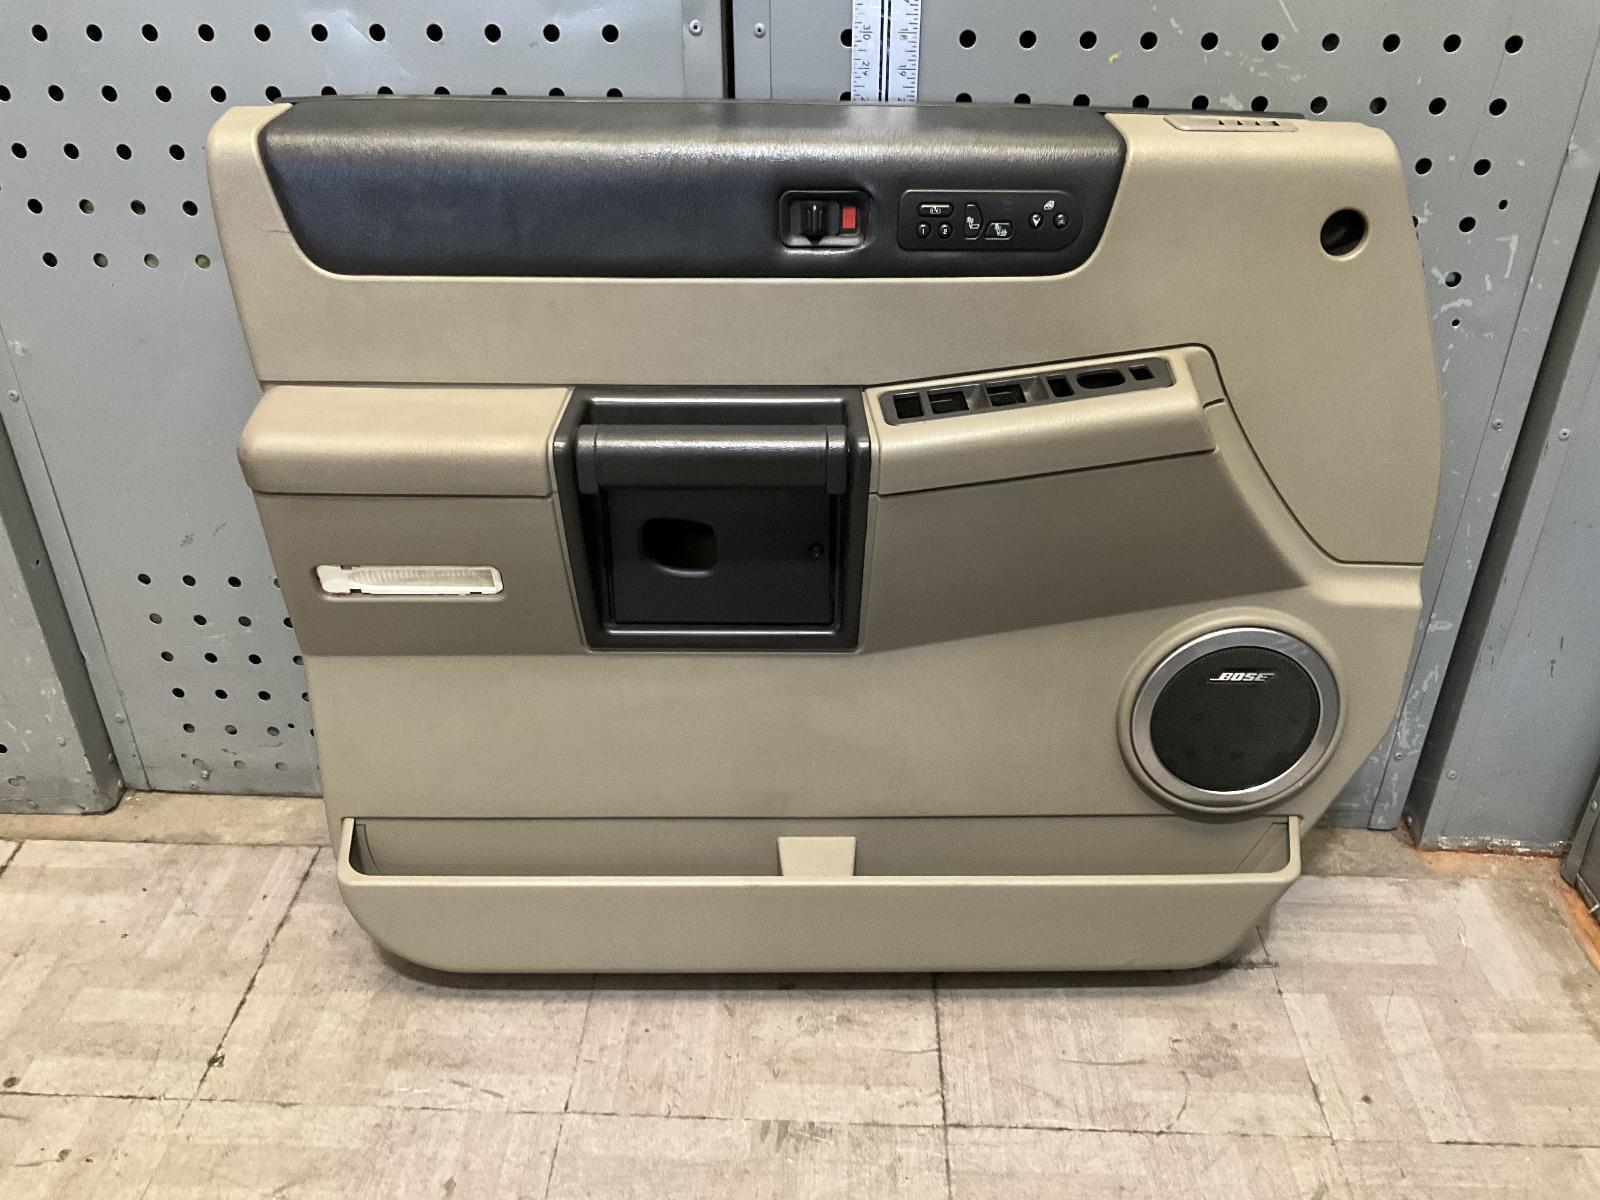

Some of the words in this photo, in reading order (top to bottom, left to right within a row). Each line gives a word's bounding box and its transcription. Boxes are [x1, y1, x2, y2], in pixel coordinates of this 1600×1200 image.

[863, 24, 871, 41] 30
[899, 64, 907, 77] 19
[1209, 672, 1276, 682] BOSE
